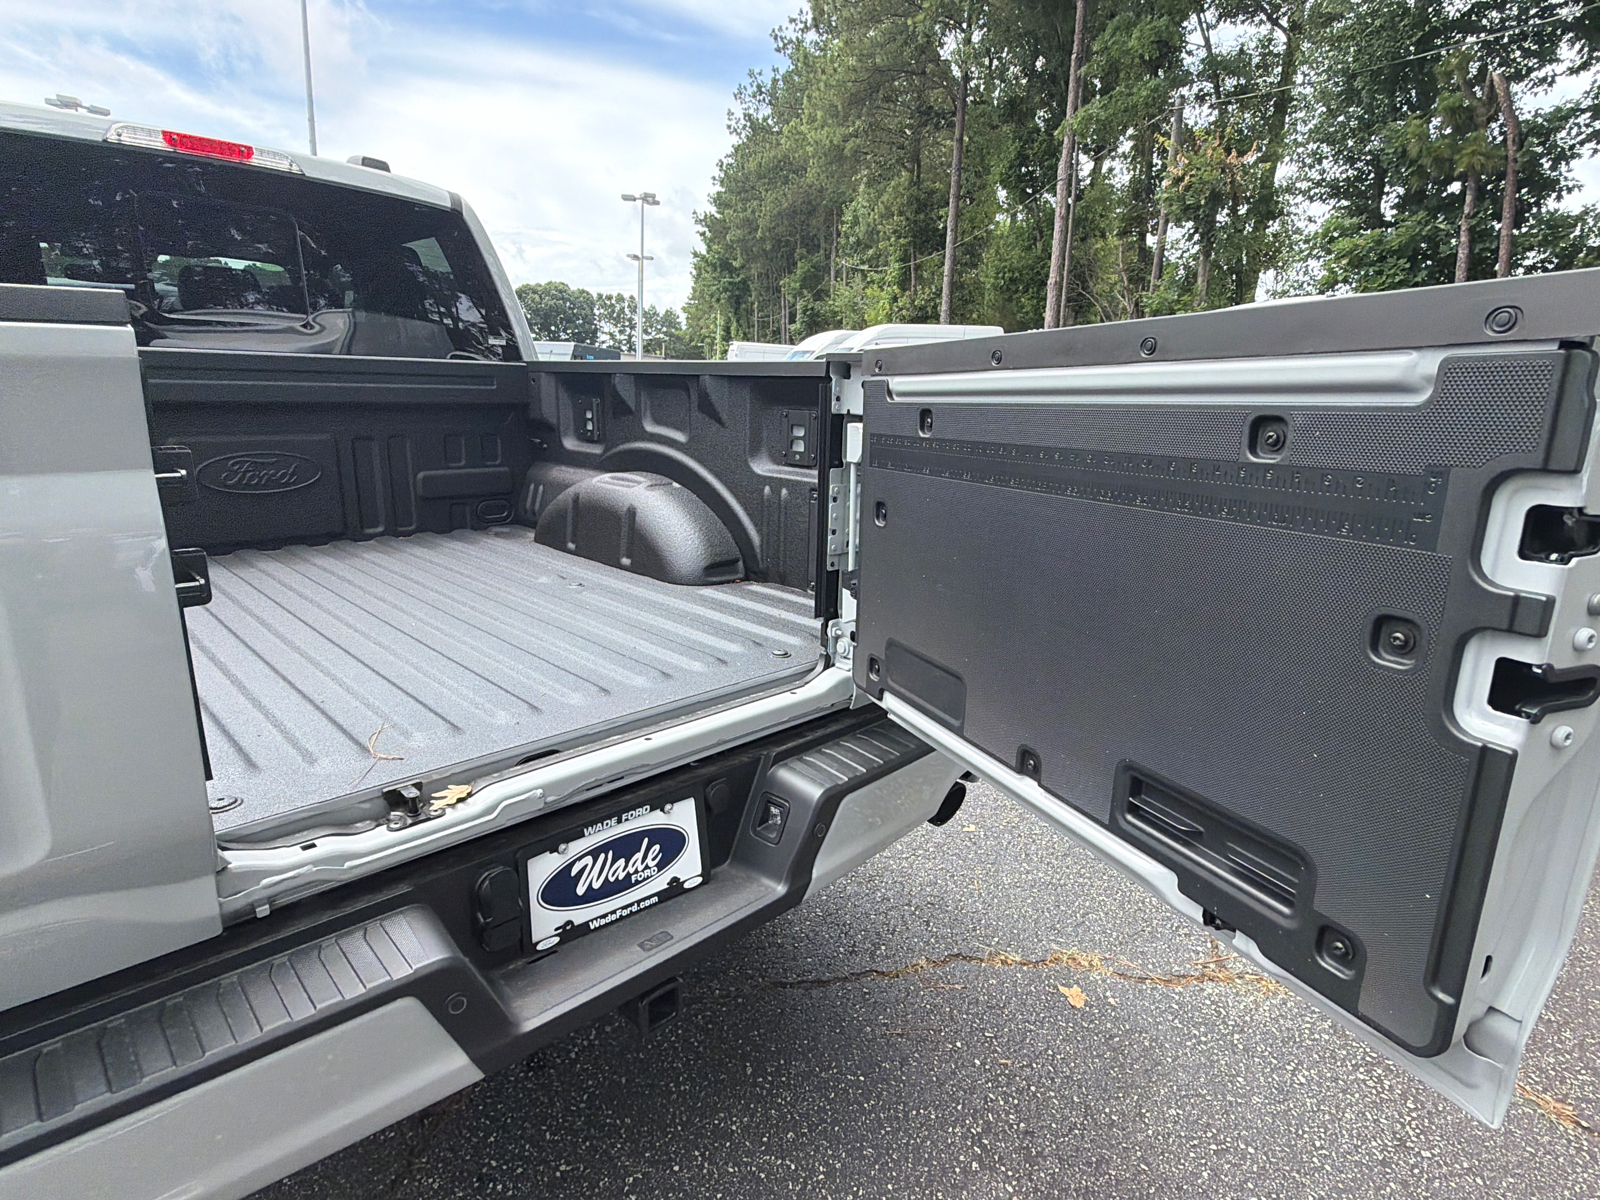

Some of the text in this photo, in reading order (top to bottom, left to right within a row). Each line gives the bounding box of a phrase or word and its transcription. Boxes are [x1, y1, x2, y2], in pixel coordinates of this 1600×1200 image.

[220, 457, 299, 485] Ford
[1323, 474, 1333, 485] 3
[1355, 476, 1365, 488] 2
[583, 804, 651, 837] WADE FORD
[570, 837, 662, 897] Wade
[631, 866, 658, 884] FORD
[588, 896, 659, 930] WadeFord.com
